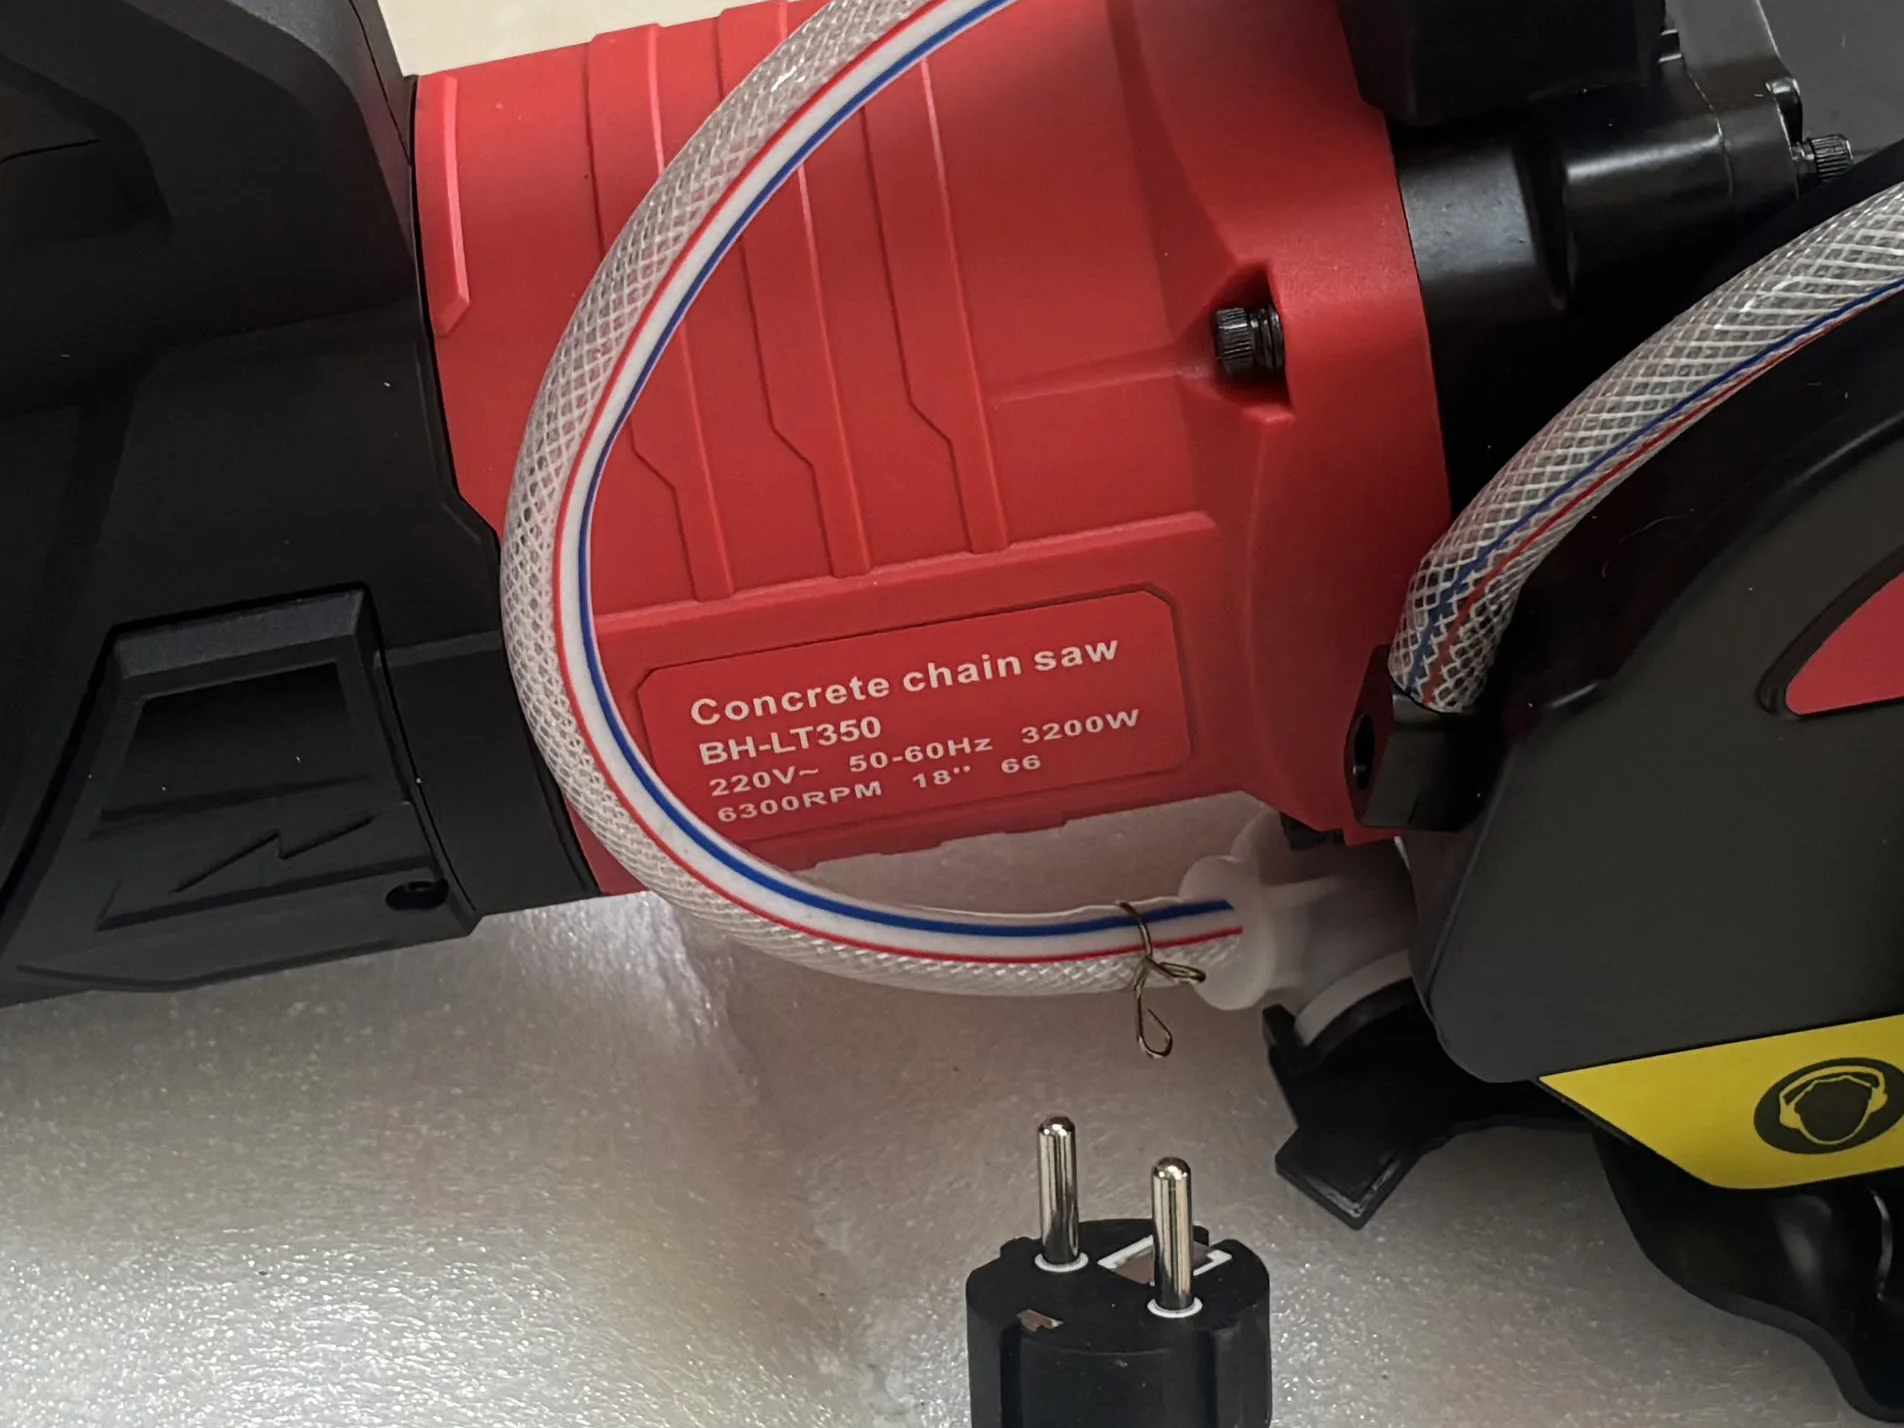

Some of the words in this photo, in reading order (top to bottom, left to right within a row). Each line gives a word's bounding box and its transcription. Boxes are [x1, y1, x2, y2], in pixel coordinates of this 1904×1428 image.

[690, 676, 890, 725] Concrete
[902, 654, 1022, 692] chain
[1033, 639, 1119, 672] saw
[698, 716, 882, 766] BH-LT350
[849, 737, 993, 773] 50-60Hz
[1021, 708, 1139, 744] 3200W
[717, 780, 883, 822] 6300RPM
[1000, 754, 1041, 774] 66
